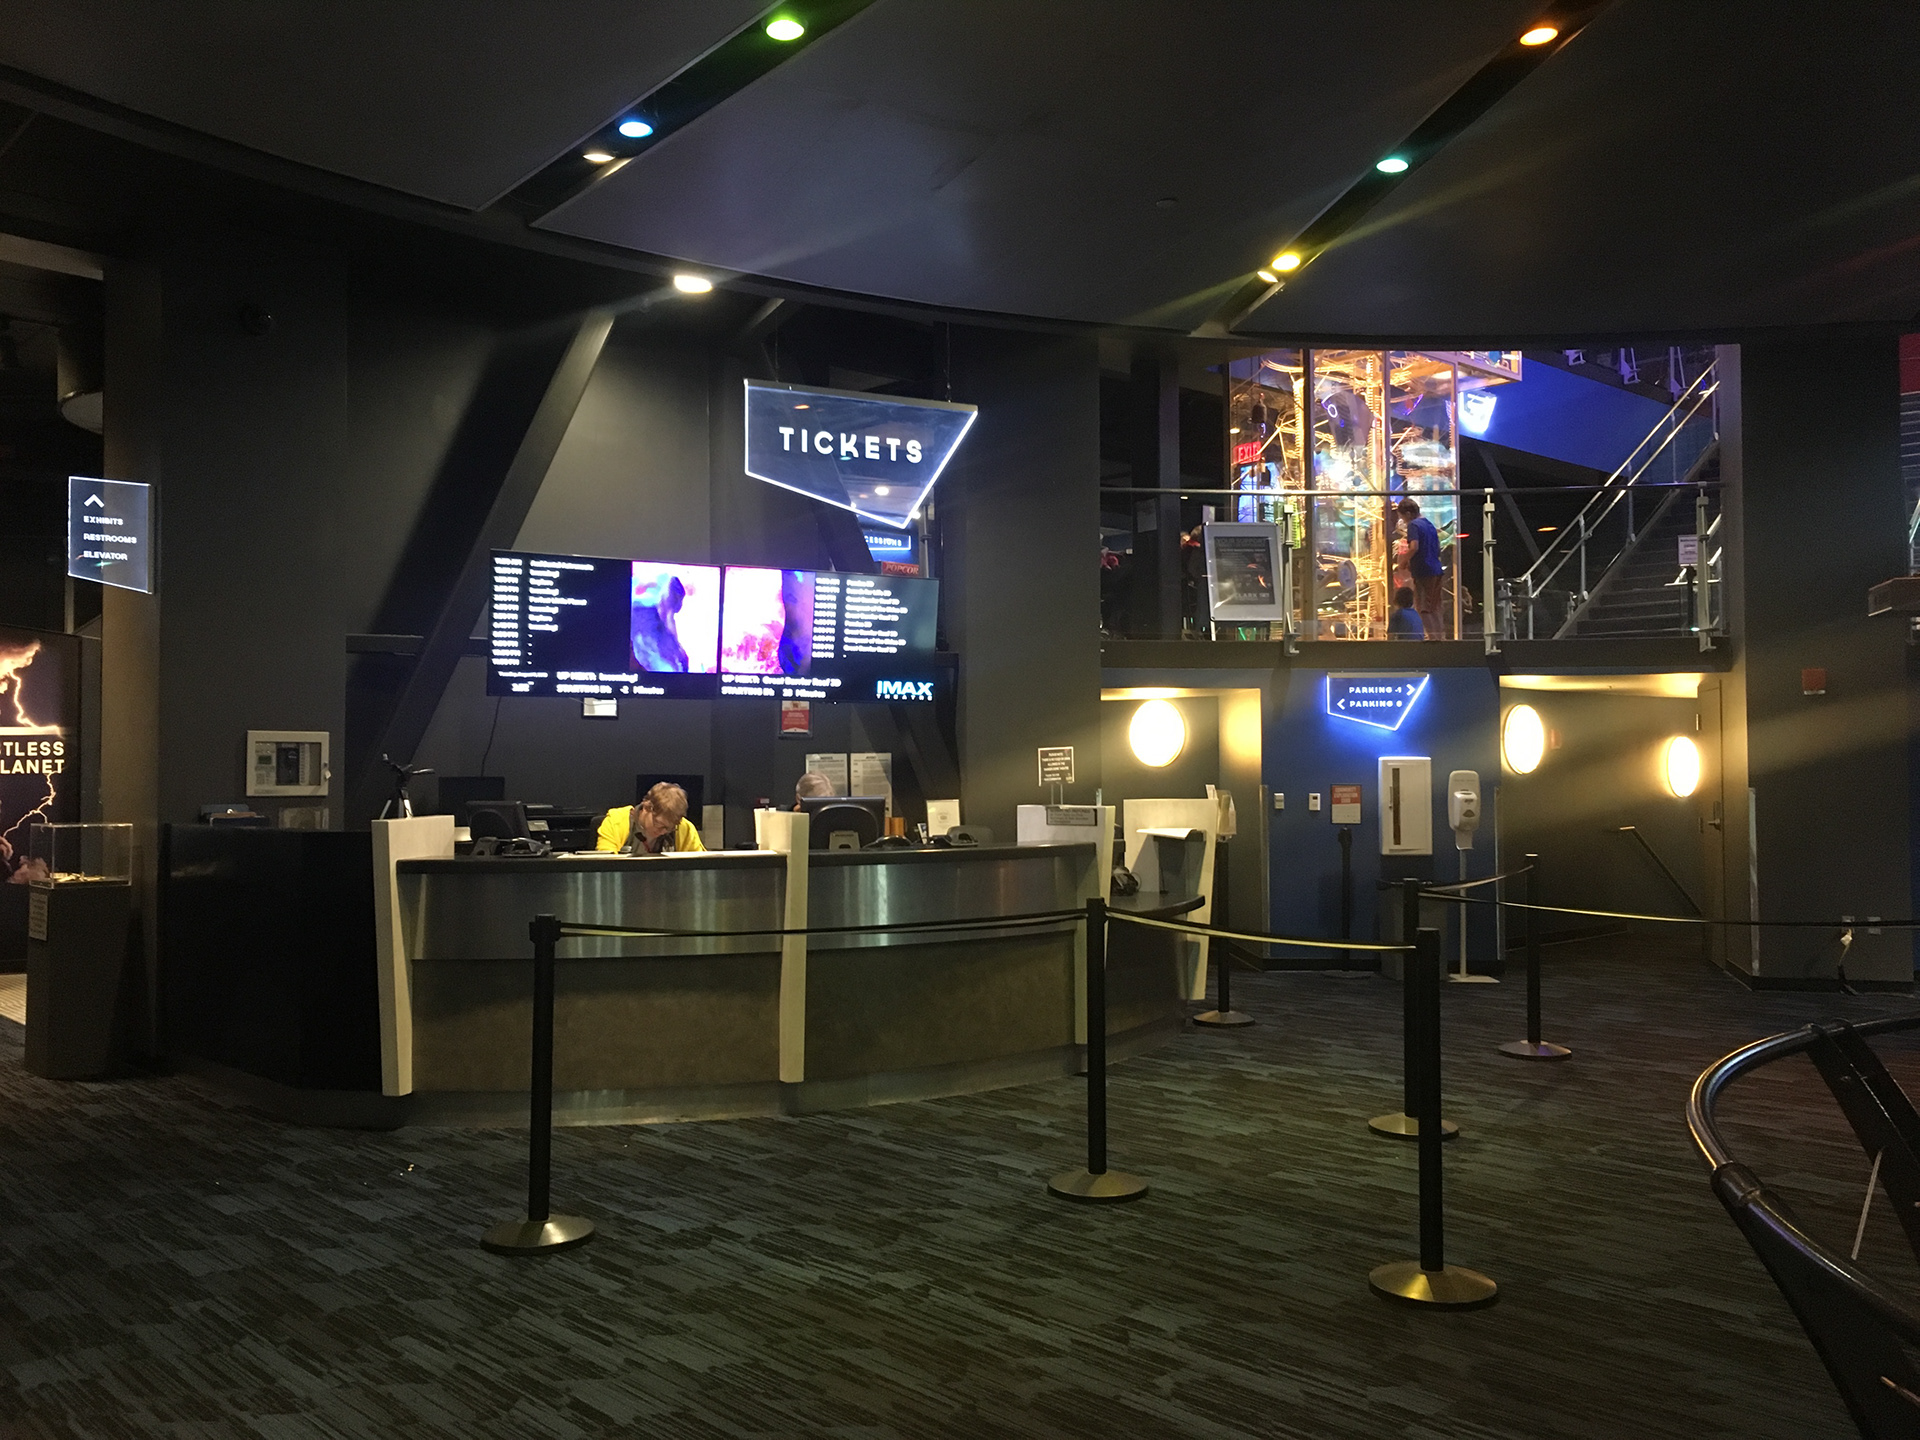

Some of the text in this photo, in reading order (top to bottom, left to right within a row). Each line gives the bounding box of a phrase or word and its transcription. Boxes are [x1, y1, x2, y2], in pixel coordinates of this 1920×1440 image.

[778, 426, 923, 464] TICKETS
[83, 515, 124, 526] EXHIBITS
[83, 533, 137, 544] RESTROOMS
[83, 550, 128, 561] ELEVATOR
[876, 680, 934, 696] IMAX
[1348, 686, 1392, 694] PARKING
[1349, 700, 1393, 708] PARKING
[0, 741, 65, 756] TLESS
[0, 759, 65, 774] LANET
